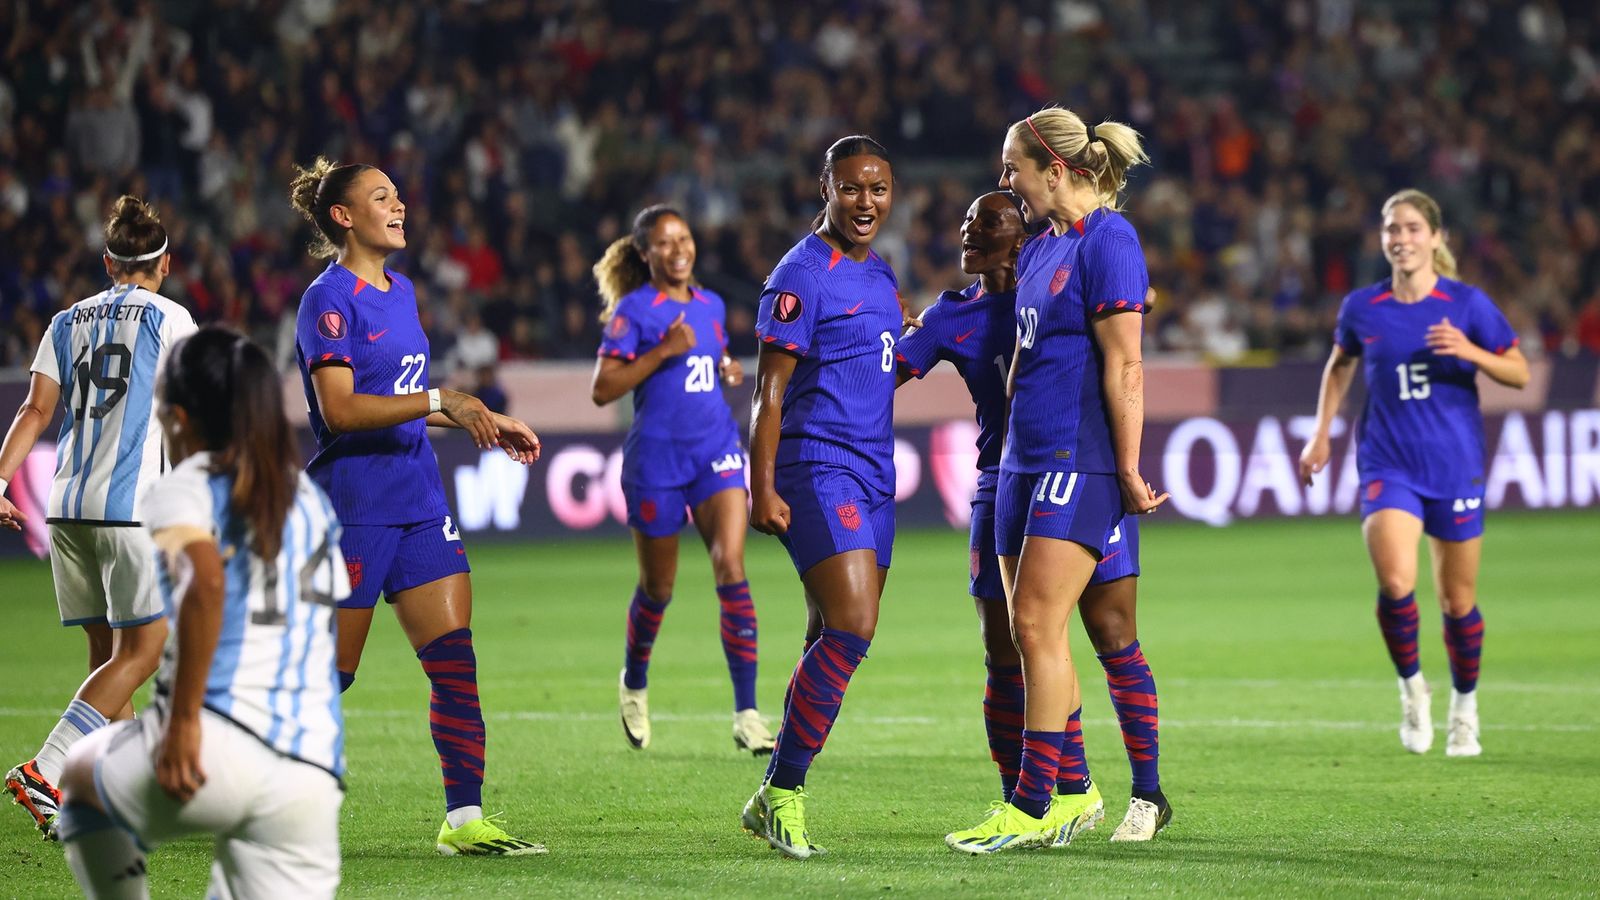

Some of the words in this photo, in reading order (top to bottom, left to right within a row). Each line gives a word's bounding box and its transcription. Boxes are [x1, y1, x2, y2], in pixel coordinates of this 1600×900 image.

[880, 331, 895, 373] 8
[73, 343, 131, 421] 19
[394, 353, 426, 395] 22
[685, 355, 714, 393] 20
[1395, 363, 1431, 400] 15
[1036, 472, 1079, 506] 10
[442, 515, 461, 542] 2
